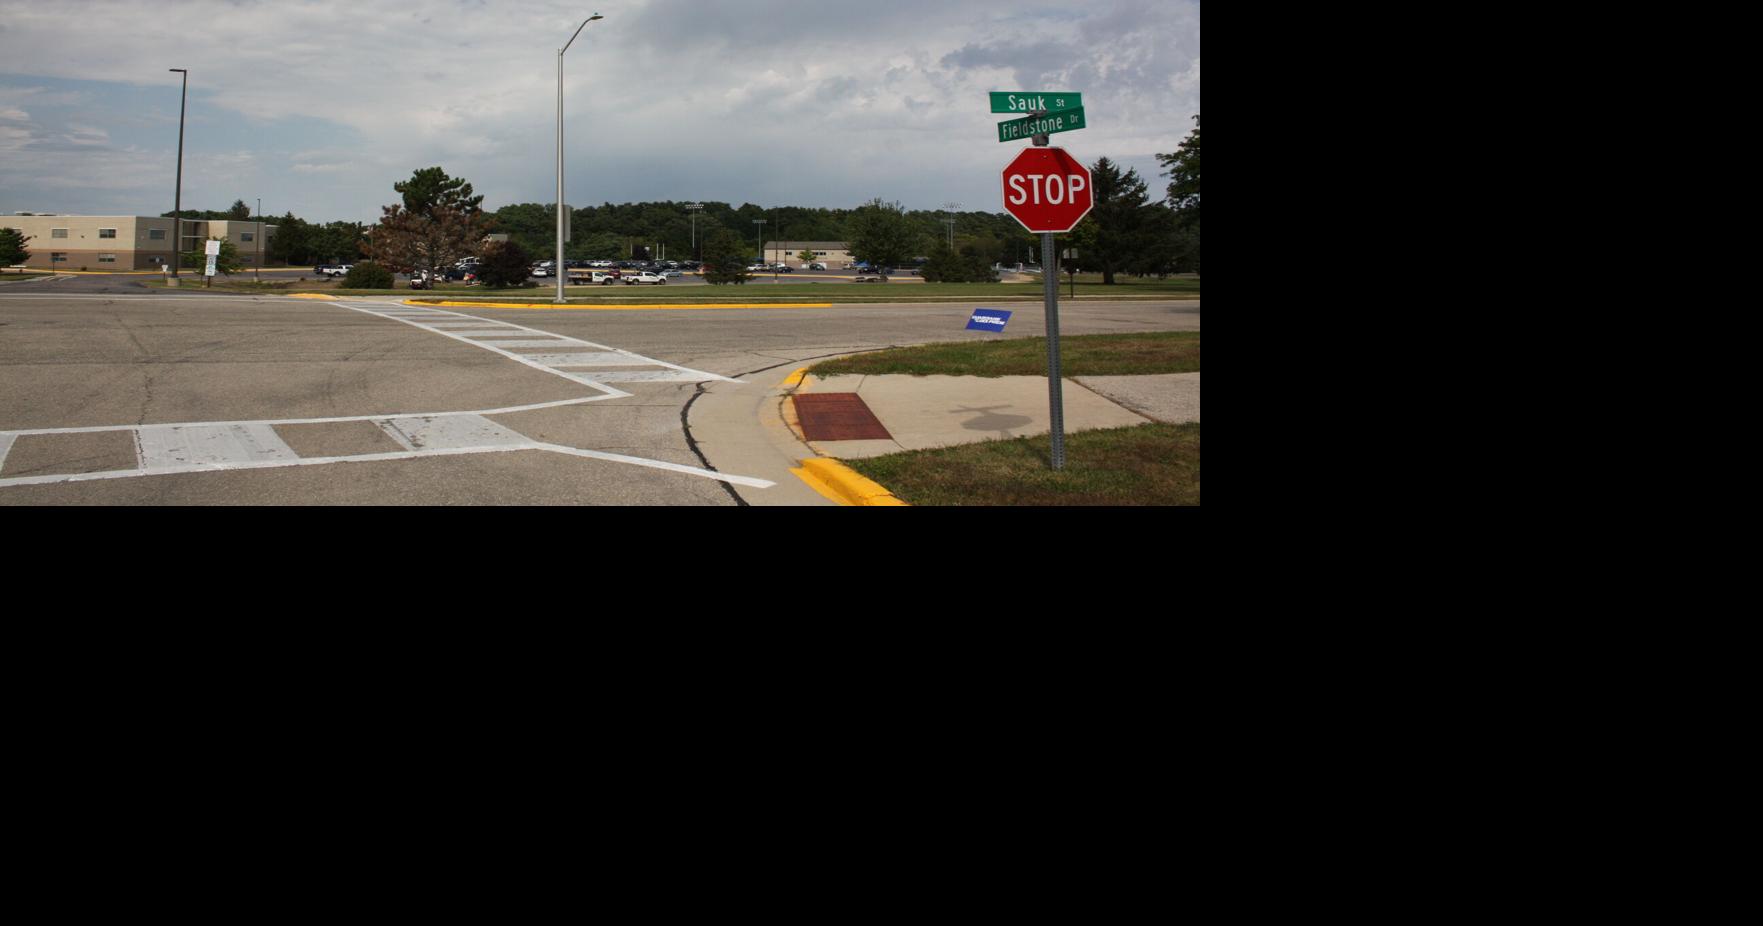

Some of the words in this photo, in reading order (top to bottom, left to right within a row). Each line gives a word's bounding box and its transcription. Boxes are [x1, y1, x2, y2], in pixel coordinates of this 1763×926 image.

[1008, 95, 1046, 111] Sauk
[1056, 98, 1065, 107] St
[1002, 116, 1063, 139] Fieldstone
[1070, 114, 1079, 124] Dr
[1009, 174, 1085, 205] STOP
